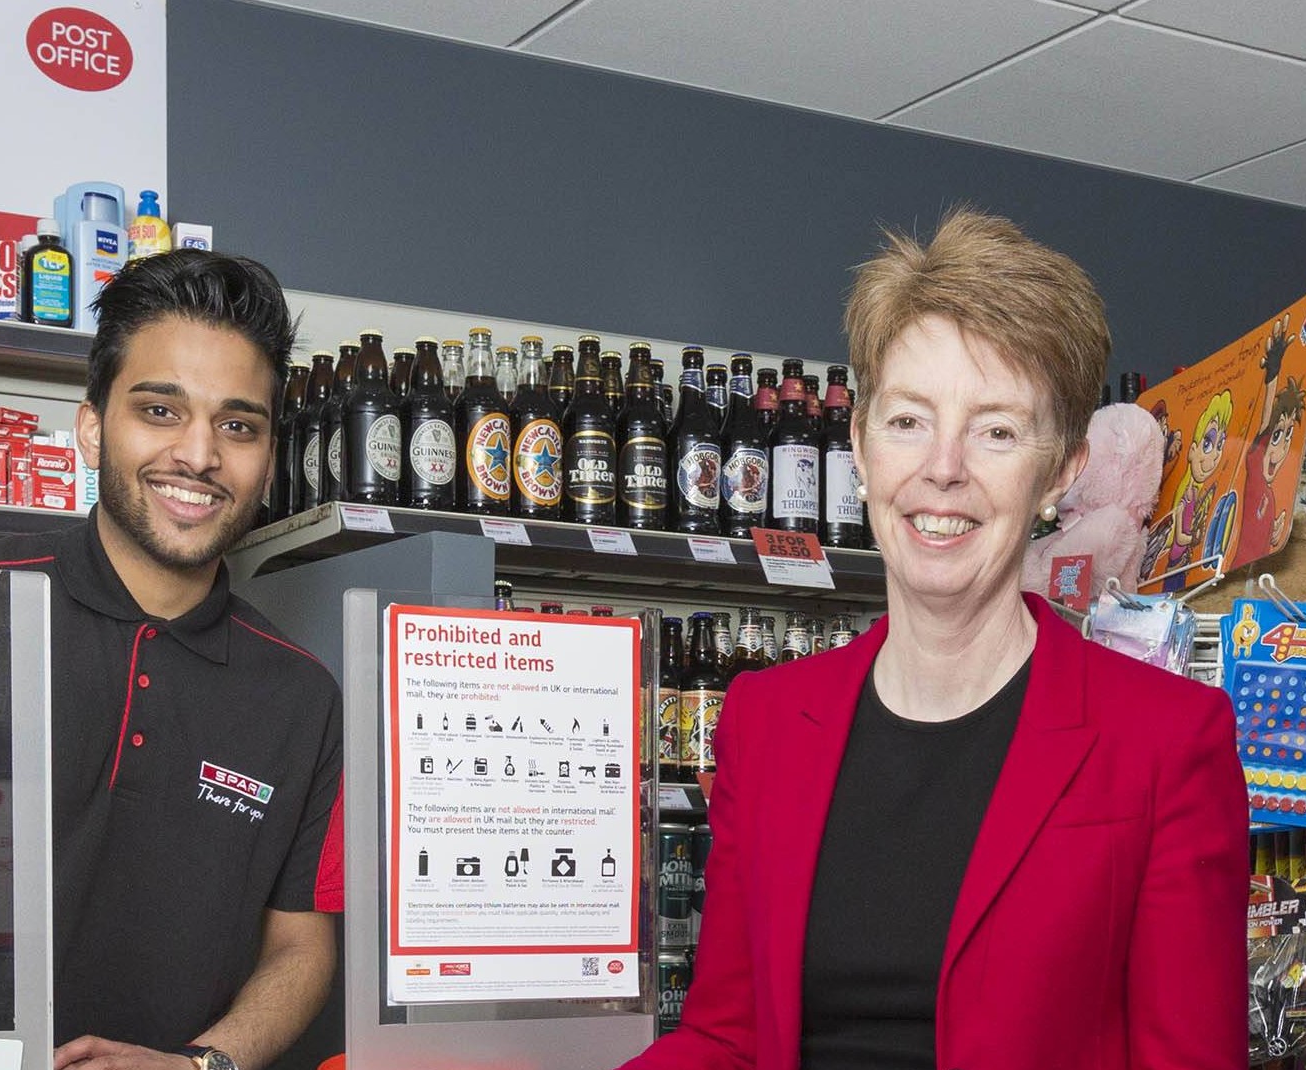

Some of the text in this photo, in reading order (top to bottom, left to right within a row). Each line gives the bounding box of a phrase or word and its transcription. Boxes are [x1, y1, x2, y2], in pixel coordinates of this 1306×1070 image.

[51, 21, 112, 51] POST
[36, 43, 120, 76] OFFICE
[98, 236, 117, 246] NIVEA
[37, 458, 67, 469] Rennie
[430, 463, 445, 472] XX
[577, 458, 608, 472] OLD
[633, 463, 662, 477] OLD
[787, 489, 806, 499] OLD
[842, 496, 858, 504] OLD
[765, 534, 805, 547] 3 FOR
[768, 544, 811, 557] £5.50
[405, 622, 542, 647] Prohibited and
[405, 650, 555, 672] restricted items
[406, 678, 421, 686] The
[423, 679, 457, 690] following
[459, 681, 481, 690] items
[497, 683, 510, 691] not
[512, 683, 539, 692] allowed
[542, 684, 549, 692] in
[573, 686, 618, 695] international
[427, 691, 444, 700] they
[215, 771, 258, 795] SPAR
[198, 783, 230, 807] There
[232, 798, 248, 813] for
[408, 804, 422, 812] The
[424, 804, 459, 815] following
[461, 805, 481, 813] items
[498, 806, 510, 814] not
[512, 806, 540, 814] allowed
[551, 807, 596, 815] international
[408, 814, 426, 825] They
[443, 815, 472, 823] allowed
[483, 816, 494, 824] UK
[496, 816, 512, 824] mail
[514, 816, 527, 824] but
[529, 817, 544, 826] they
[407, 826, 421, 834] You
[445, 827, 474, 836] present
[499, 827, 519, 835] items
[531, 827, 543, 835] the
[1259, 918, 1283, 927] POWER
